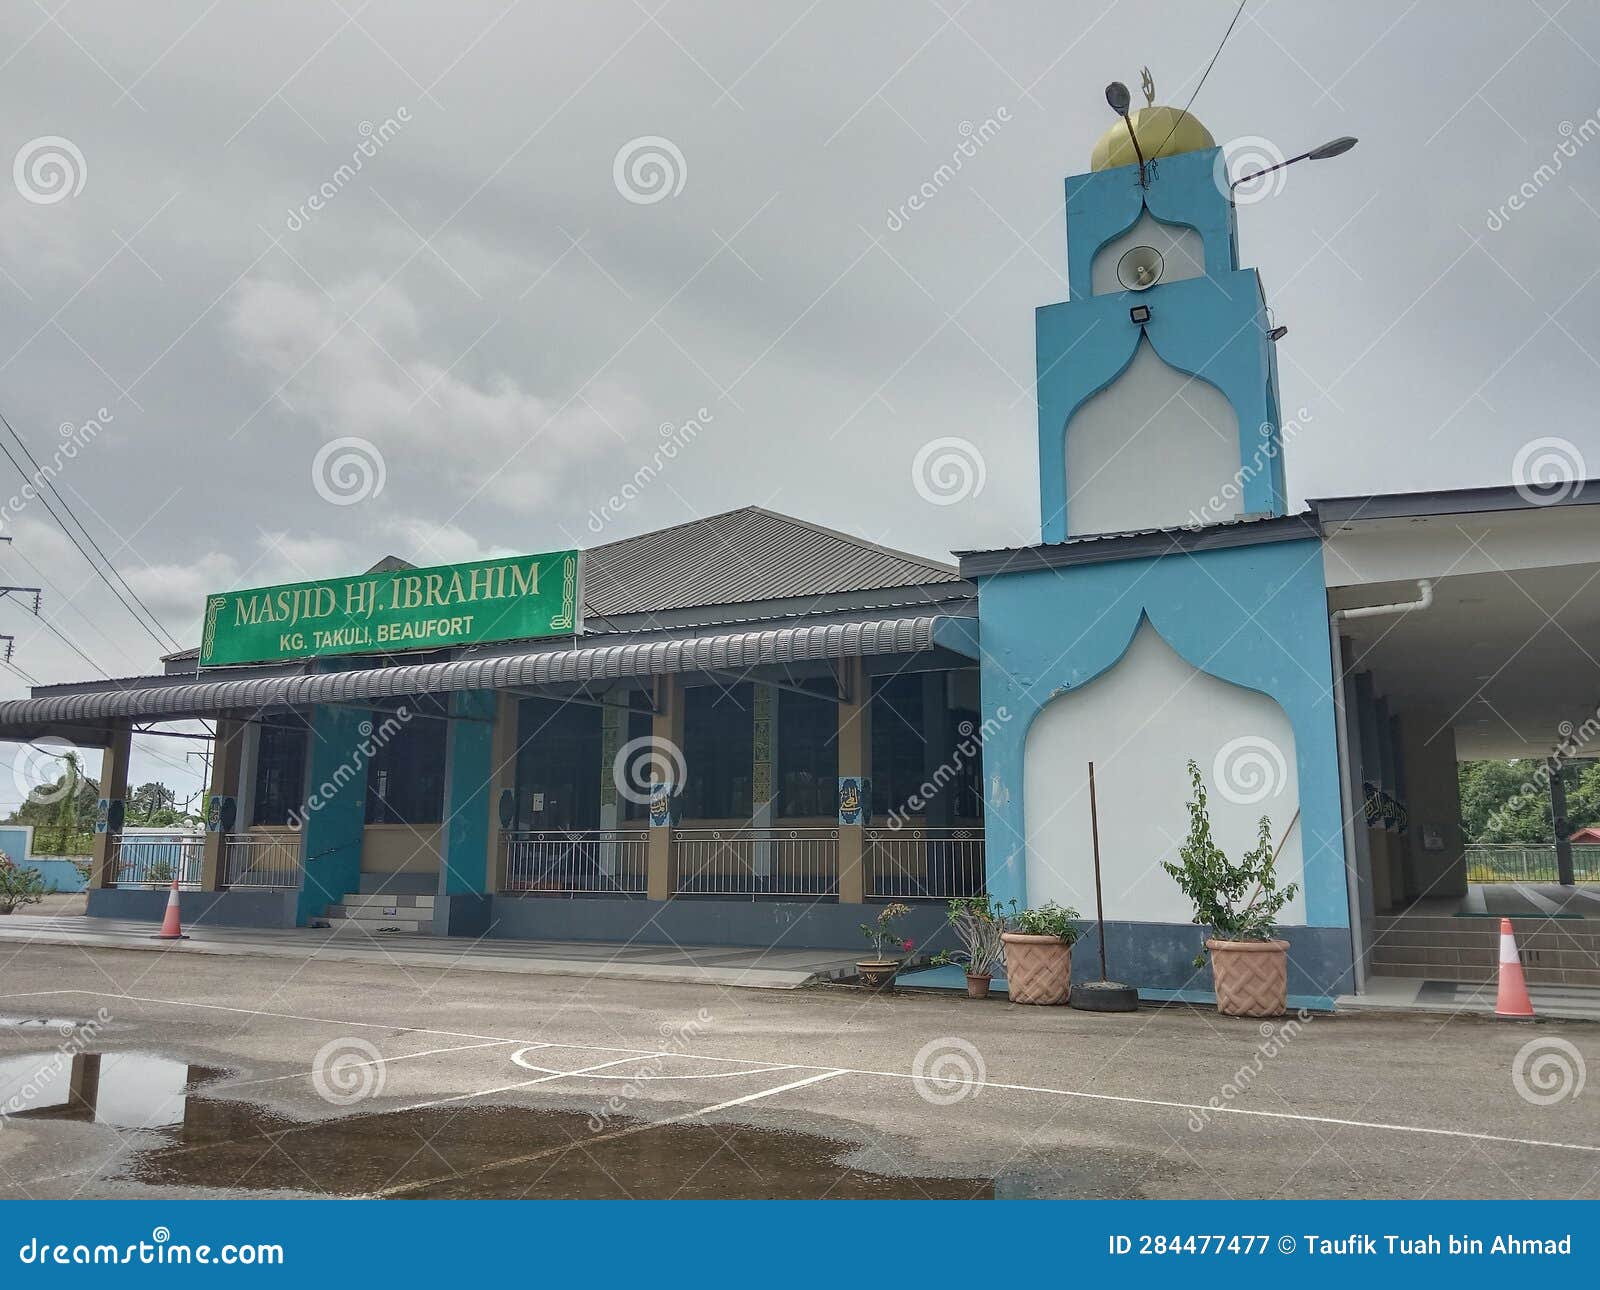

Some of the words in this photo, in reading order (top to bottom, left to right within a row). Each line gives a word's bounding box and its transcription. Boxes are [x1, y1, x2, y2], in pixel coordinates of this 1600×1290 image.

[234, 587, 336, 627] MASJID
[344, 581, 384, 619] HJ.
[388, 562, 541, 610] IBRAHIM
[279, 633, 307, 652] KG.
[313, 629, 372, 649] TAKULI,
[377, 616, 473, 642] BEAUFORT
